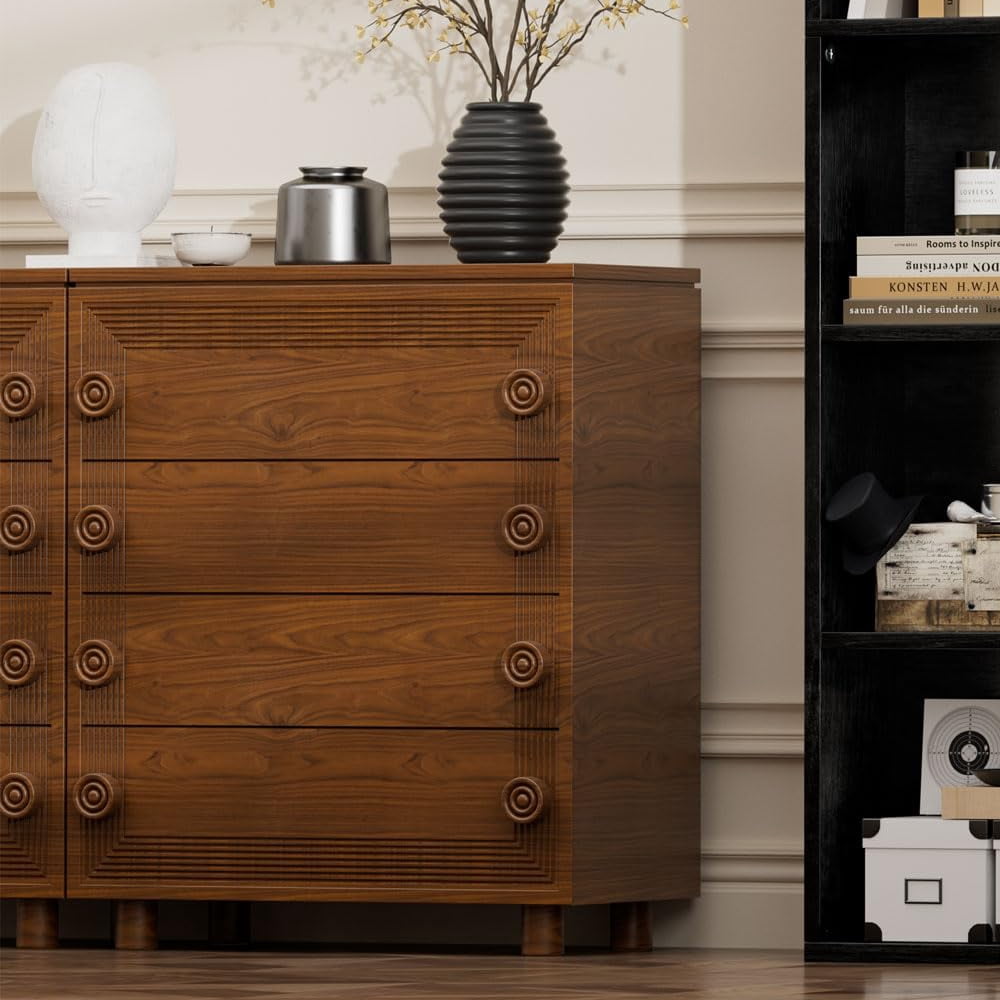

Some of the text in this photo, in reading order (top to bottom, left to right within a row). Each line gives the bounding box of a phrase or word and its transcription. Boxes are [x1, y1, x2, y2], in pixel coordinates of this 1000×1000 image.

[926, 240, 957, 248] Rooms
[959, 240, 969, 248] to
[905, 261, 968, 272] advertising
[889, 282, 948, 292] KONSTEN
[878, 305, 892, 314] für
[895, 305, 914, 314] alla
[916, 305, 932, 314] die
[935, 304, 979, 314] sünderin
